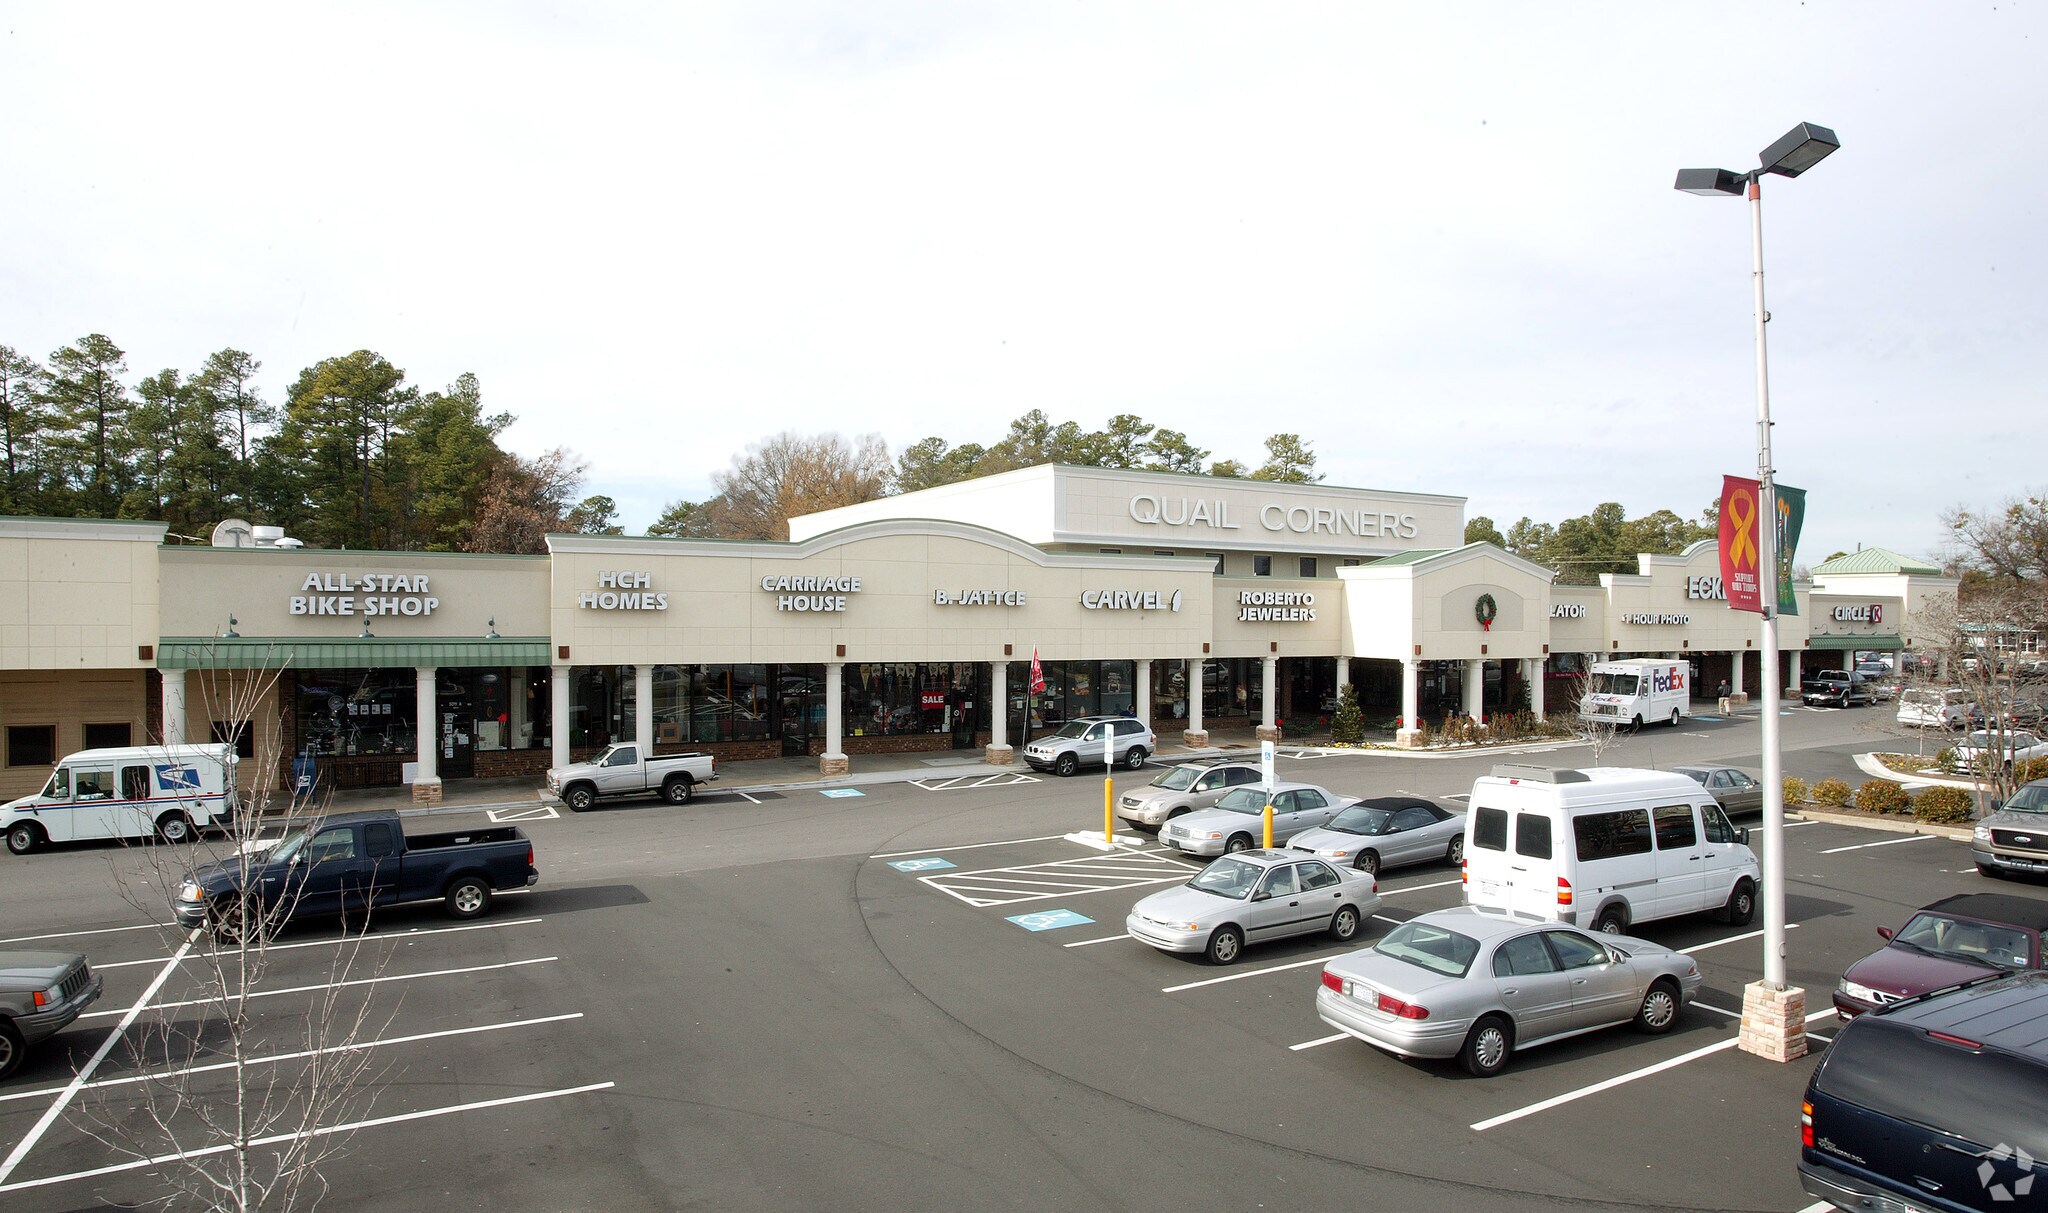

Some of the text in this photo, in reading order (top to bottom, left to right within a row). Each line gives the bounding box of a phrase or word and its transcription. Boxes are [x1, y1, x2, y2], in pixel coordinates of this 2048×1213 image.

[1129, 493, 1418, 539] QUAIL CORNERS
[301, 572, 429, 593] ALL-STAR
[599, 571, 651, 589] HCH
[762, 575, 862, 592] CARRIAGE
[580, 592, 668, 610] HOMES
[778, 595, 847, 612] HOUSE
[935, 589, 953, 605] B.
[1081, 590, 1167, 609] CARVEL
[1241, 591, 1315, 606] ROBERTO
[289, 596, 440, 616] BIKE SHOP
[1239, 607, 1317, 622] JEWELERS
[1834, 606, 1882, 622] CIRCLE K
[1632, 614, 1659, 625] HOUR
[1660, 614, 1690, 625] PHOTO
[1653, 667, 1684, 693] FedEx
[922, 695, 944, 704] SALE
